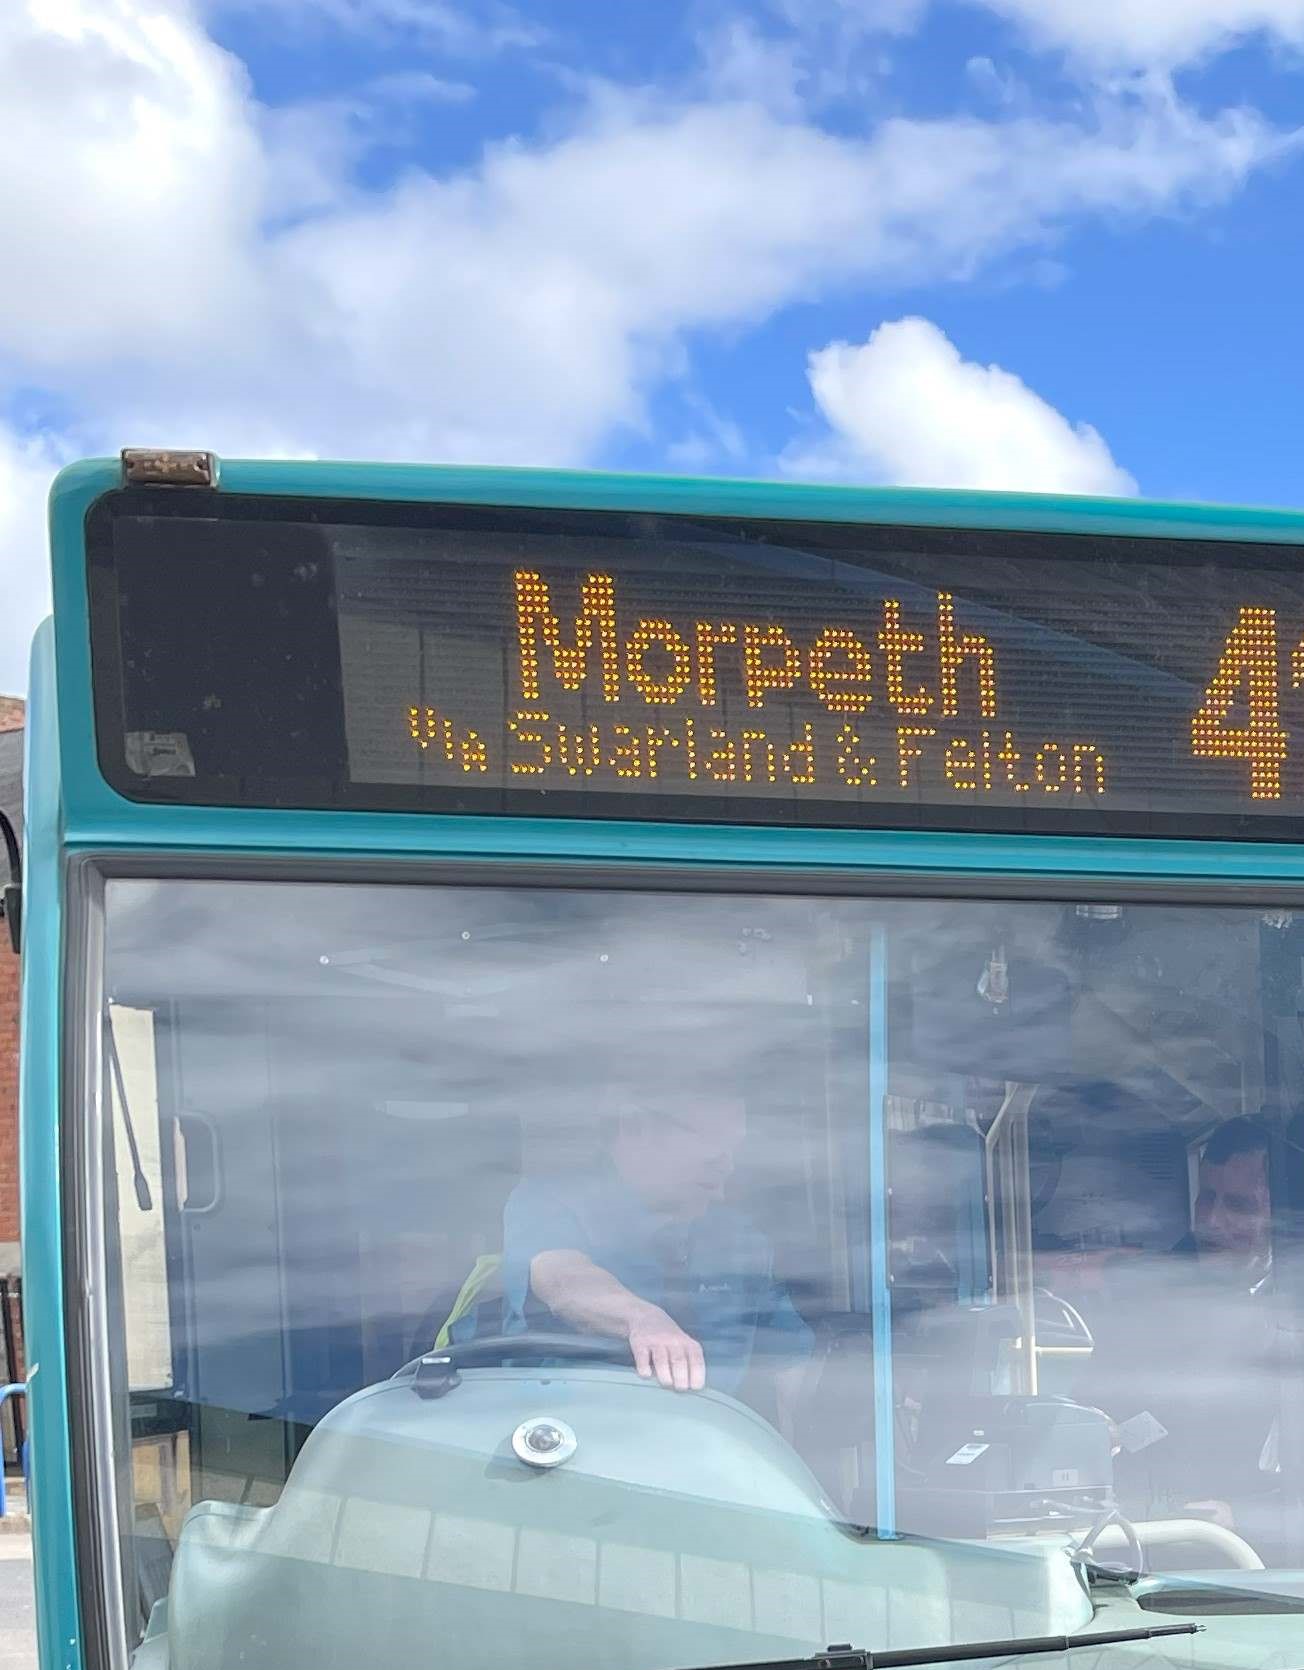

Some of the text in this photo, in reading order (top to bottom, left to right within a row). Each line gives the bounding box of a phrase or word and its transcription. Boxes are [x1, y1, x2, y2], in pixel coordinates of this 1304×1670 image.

[514, 570, 997, 720] Morpeth
[508, 710, 817, 785] Swarland
[836, 722, 877, 787] &
[896, 726, 1107, 793] Felton
